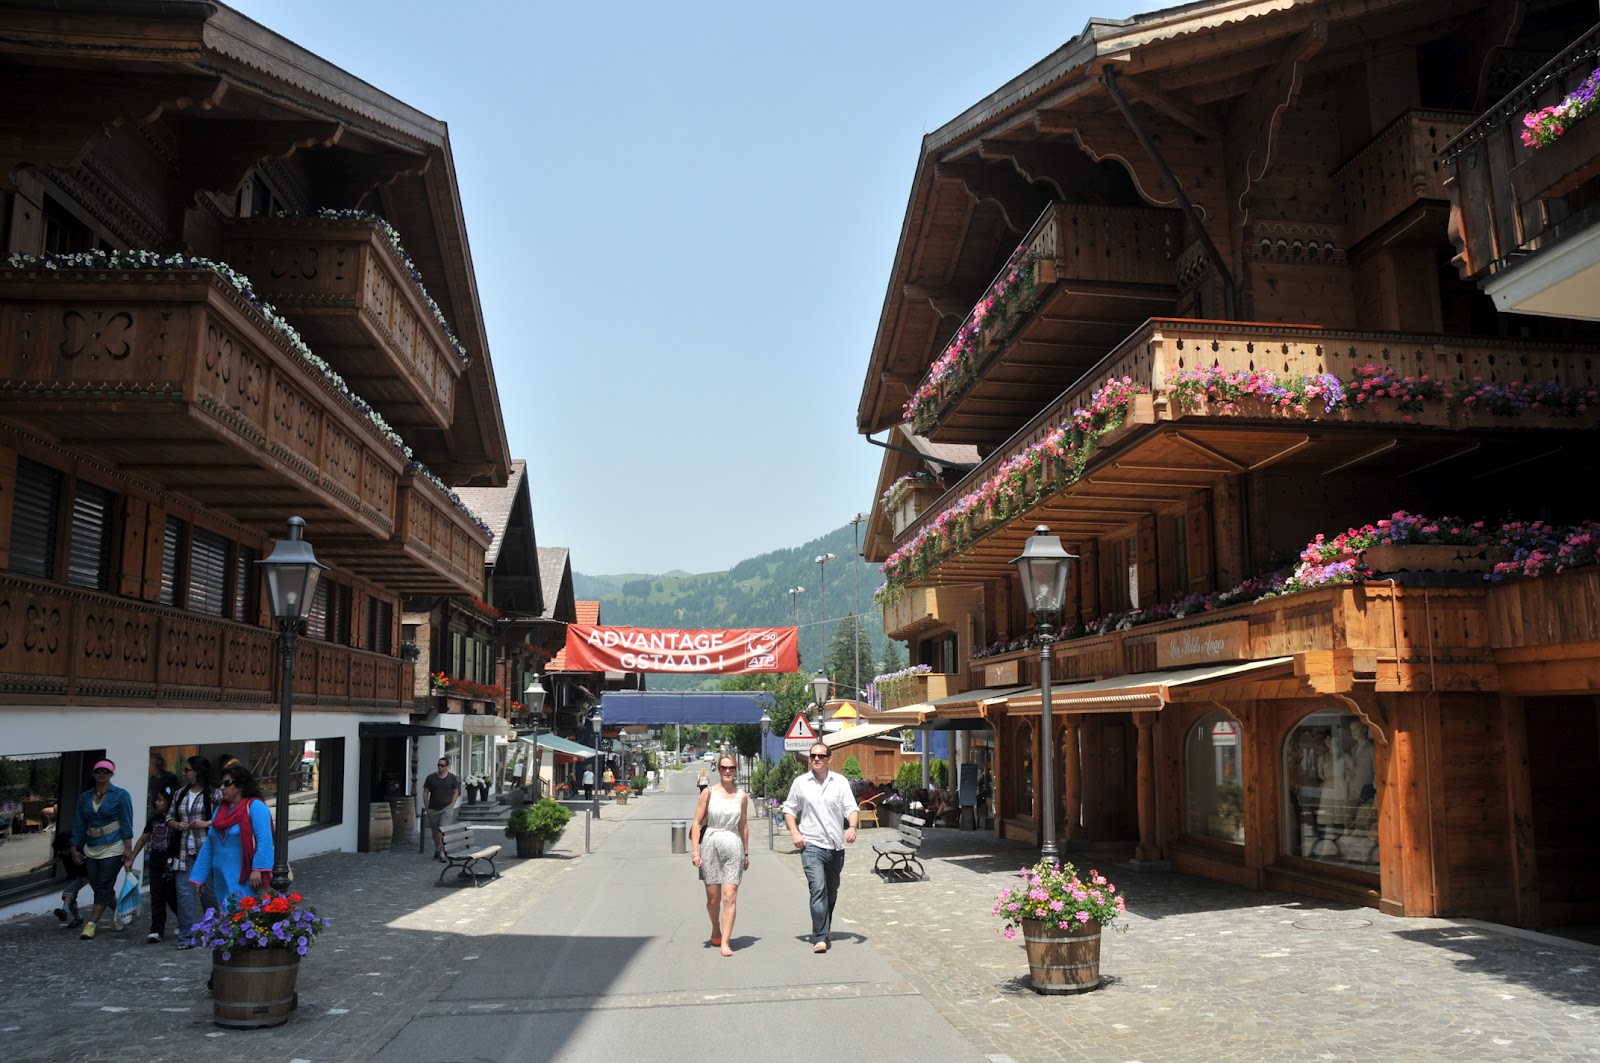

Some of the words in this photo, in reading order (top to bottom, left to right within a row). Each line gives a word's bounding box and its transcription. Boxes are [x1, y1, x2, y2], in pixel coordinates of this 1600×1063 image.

[588, 630, 724, 650] ADVANTAGE
[621, 653, 711, 670] GSTAAD
[748, 656, 775, 665] ATP
